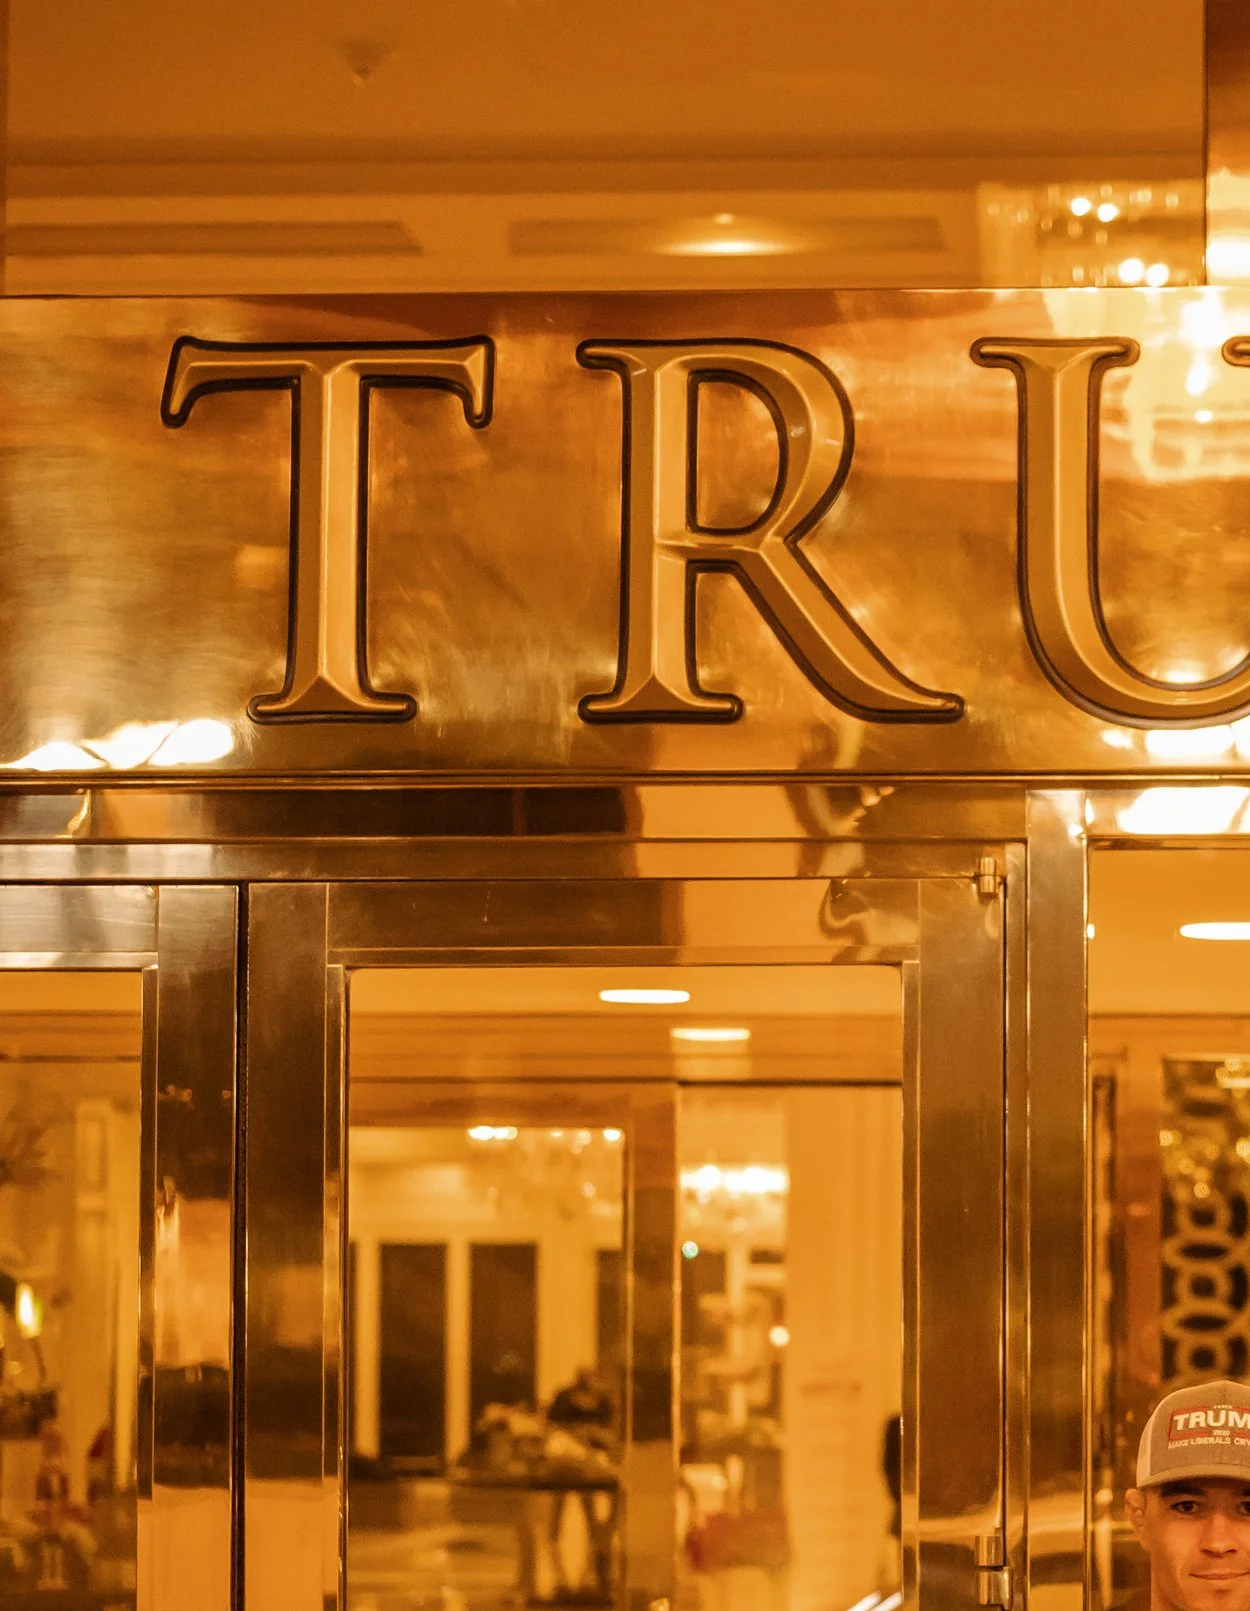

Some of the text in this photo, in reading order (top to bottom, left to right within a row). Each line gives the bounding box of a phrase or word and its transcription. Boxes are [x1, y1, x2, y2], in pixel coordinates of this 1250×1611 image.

[1168, 1439, 1189, 1449] MAKE
[1191, 1437, 1231, 1445] LIBERALS
[1234, 1437, 1250, 1446] CRY
